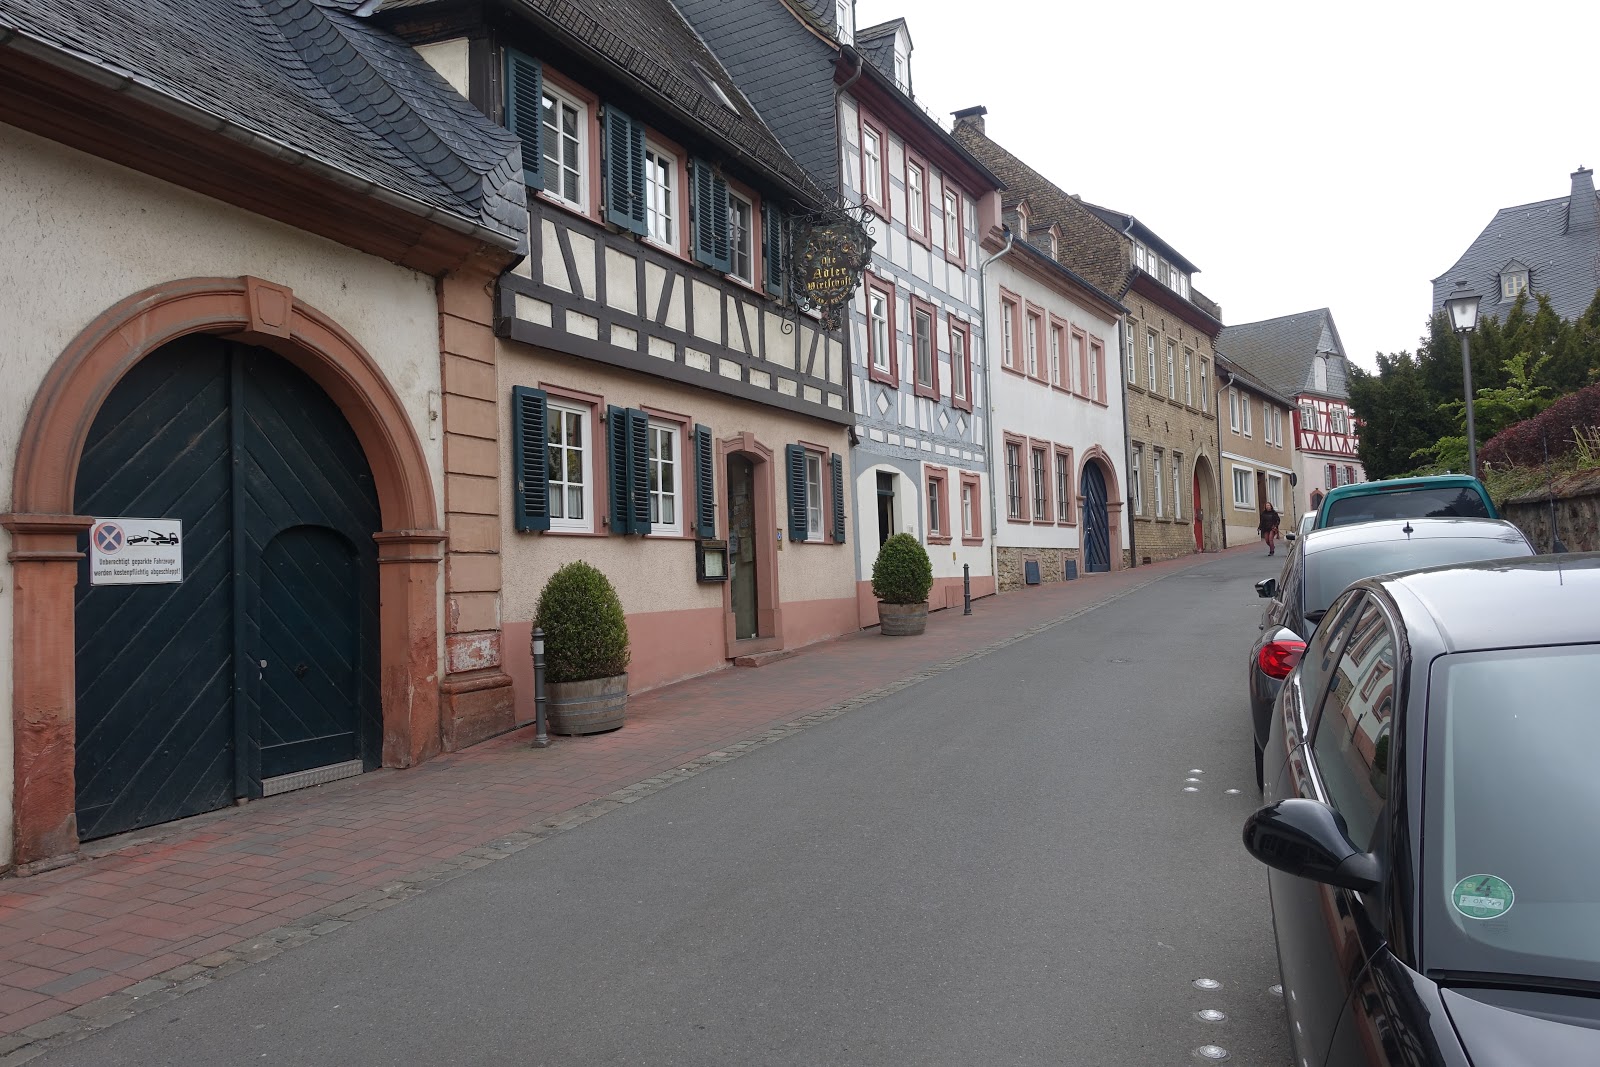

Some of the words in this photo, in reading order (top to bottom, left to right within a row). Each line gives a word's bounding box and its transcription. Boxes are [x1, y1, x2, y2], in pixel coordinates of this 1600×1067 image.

[812, 266, 847, 279] Adler
[99, 558, 130, 567] Unberechtigt
[131, 558, 153, 566] geparkte
[153, 557, 176, 566] Fahrzeuge
[113, 568, 149, 577] kostenpflichtig
[150, 567, 181, 577] abgeschleppt!
[1475, 877, 1491, 897] 4
